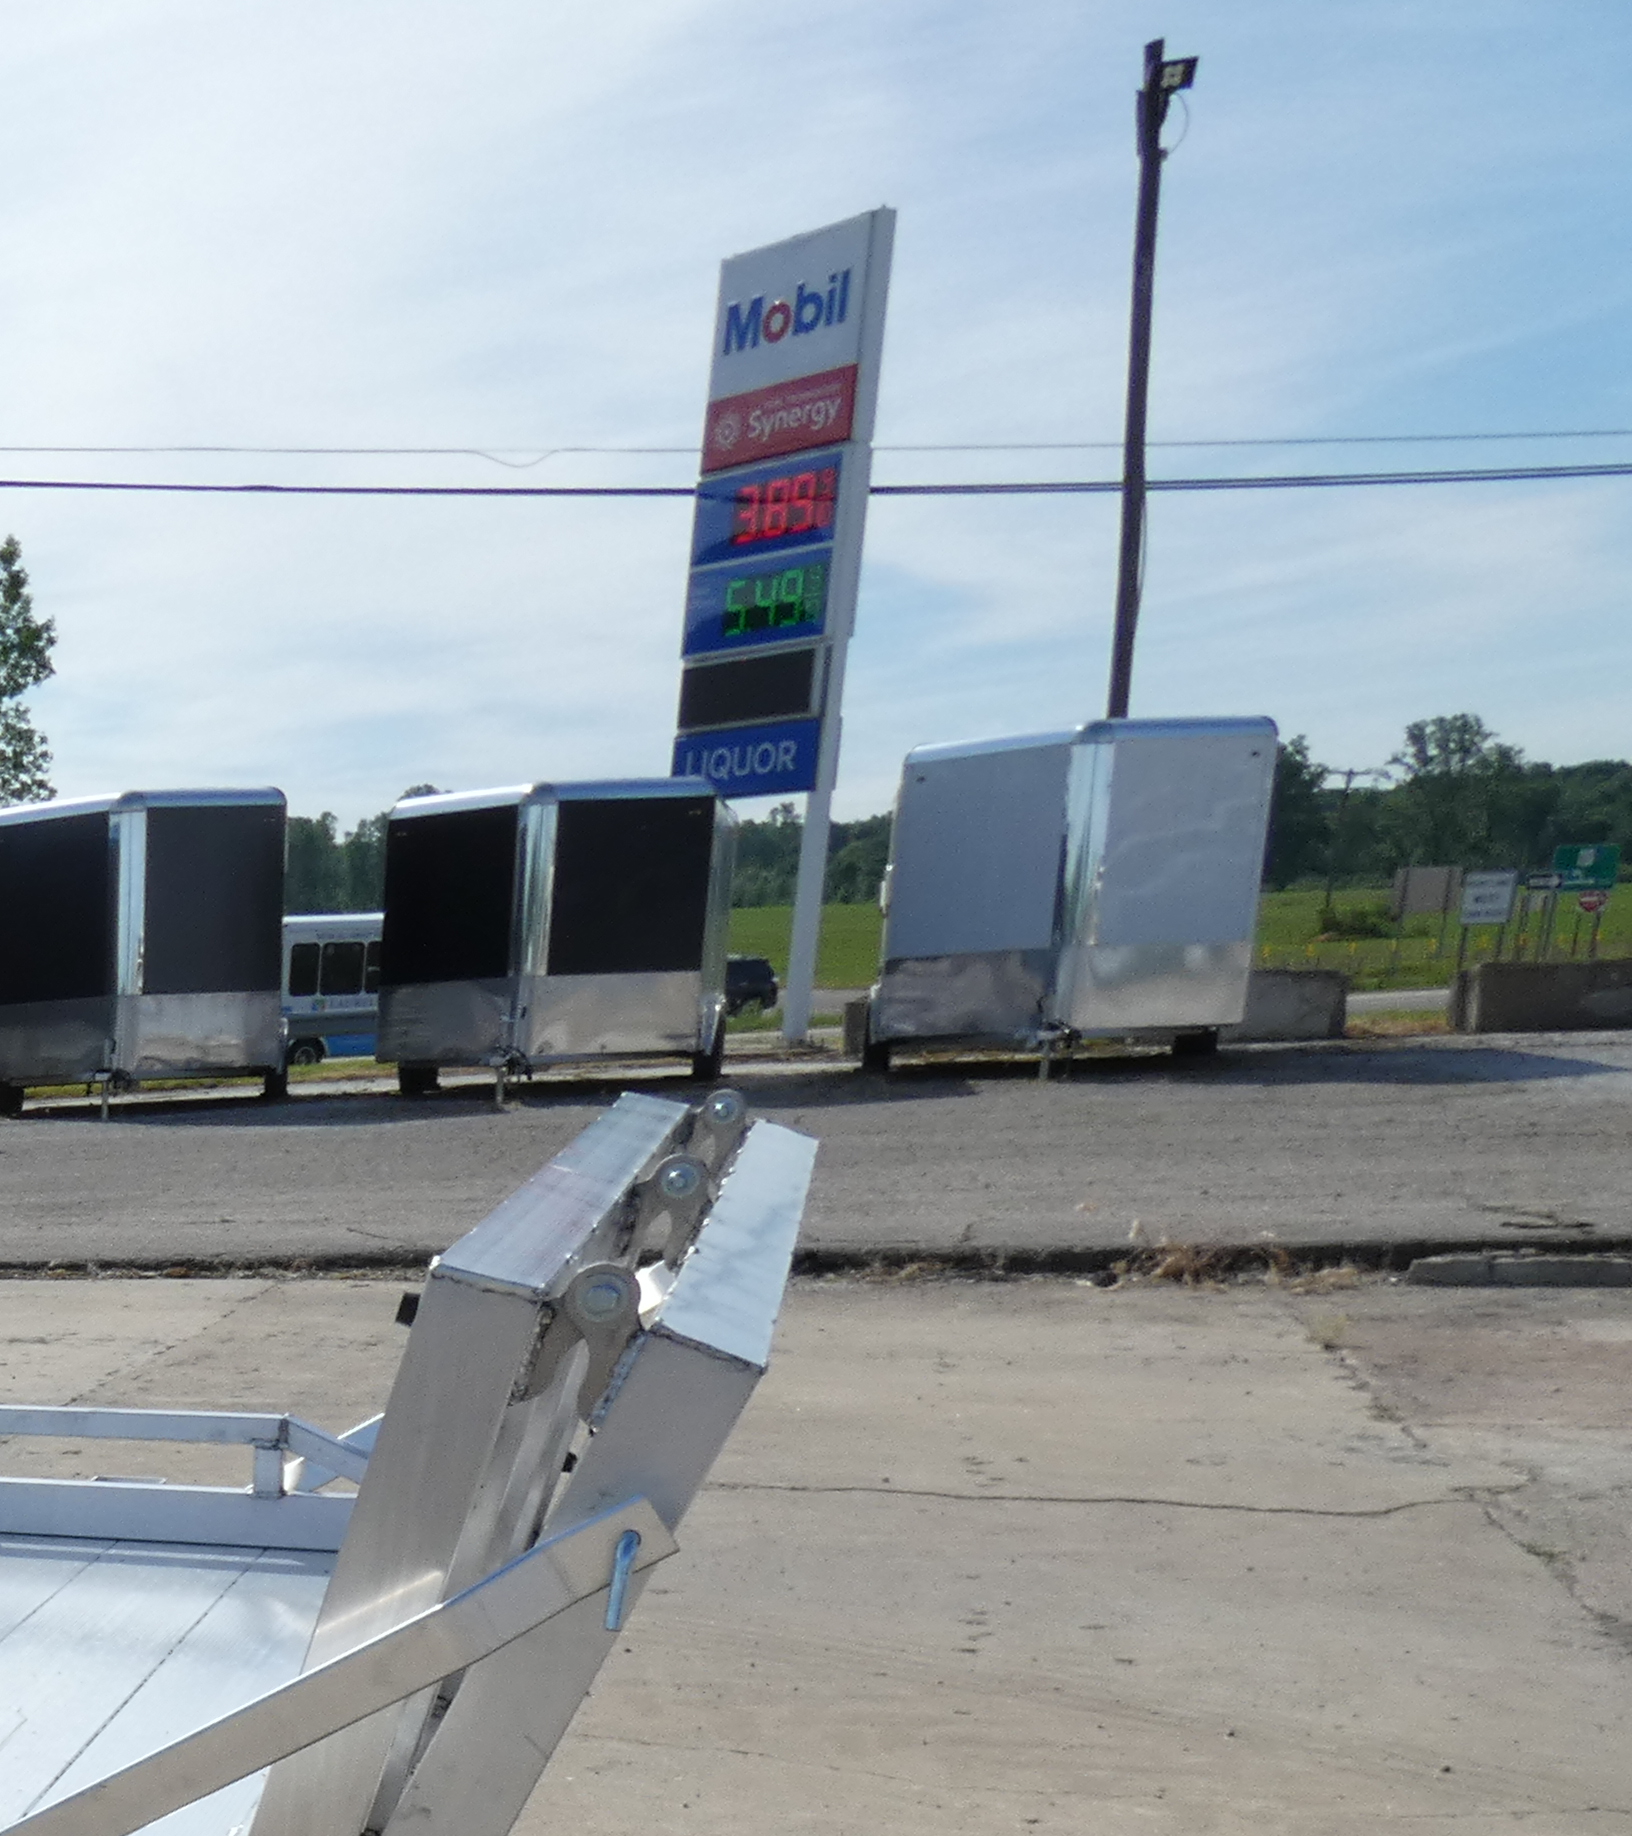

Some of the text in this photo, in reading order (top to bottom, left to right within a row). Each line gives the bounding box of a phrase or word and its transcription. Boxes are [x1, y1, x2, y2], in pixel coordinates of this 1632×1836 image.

[723, 268, 851, 355] Mobil
[748, 398, 842, 441] Synergy
[725, 569, 805, 636] 549
